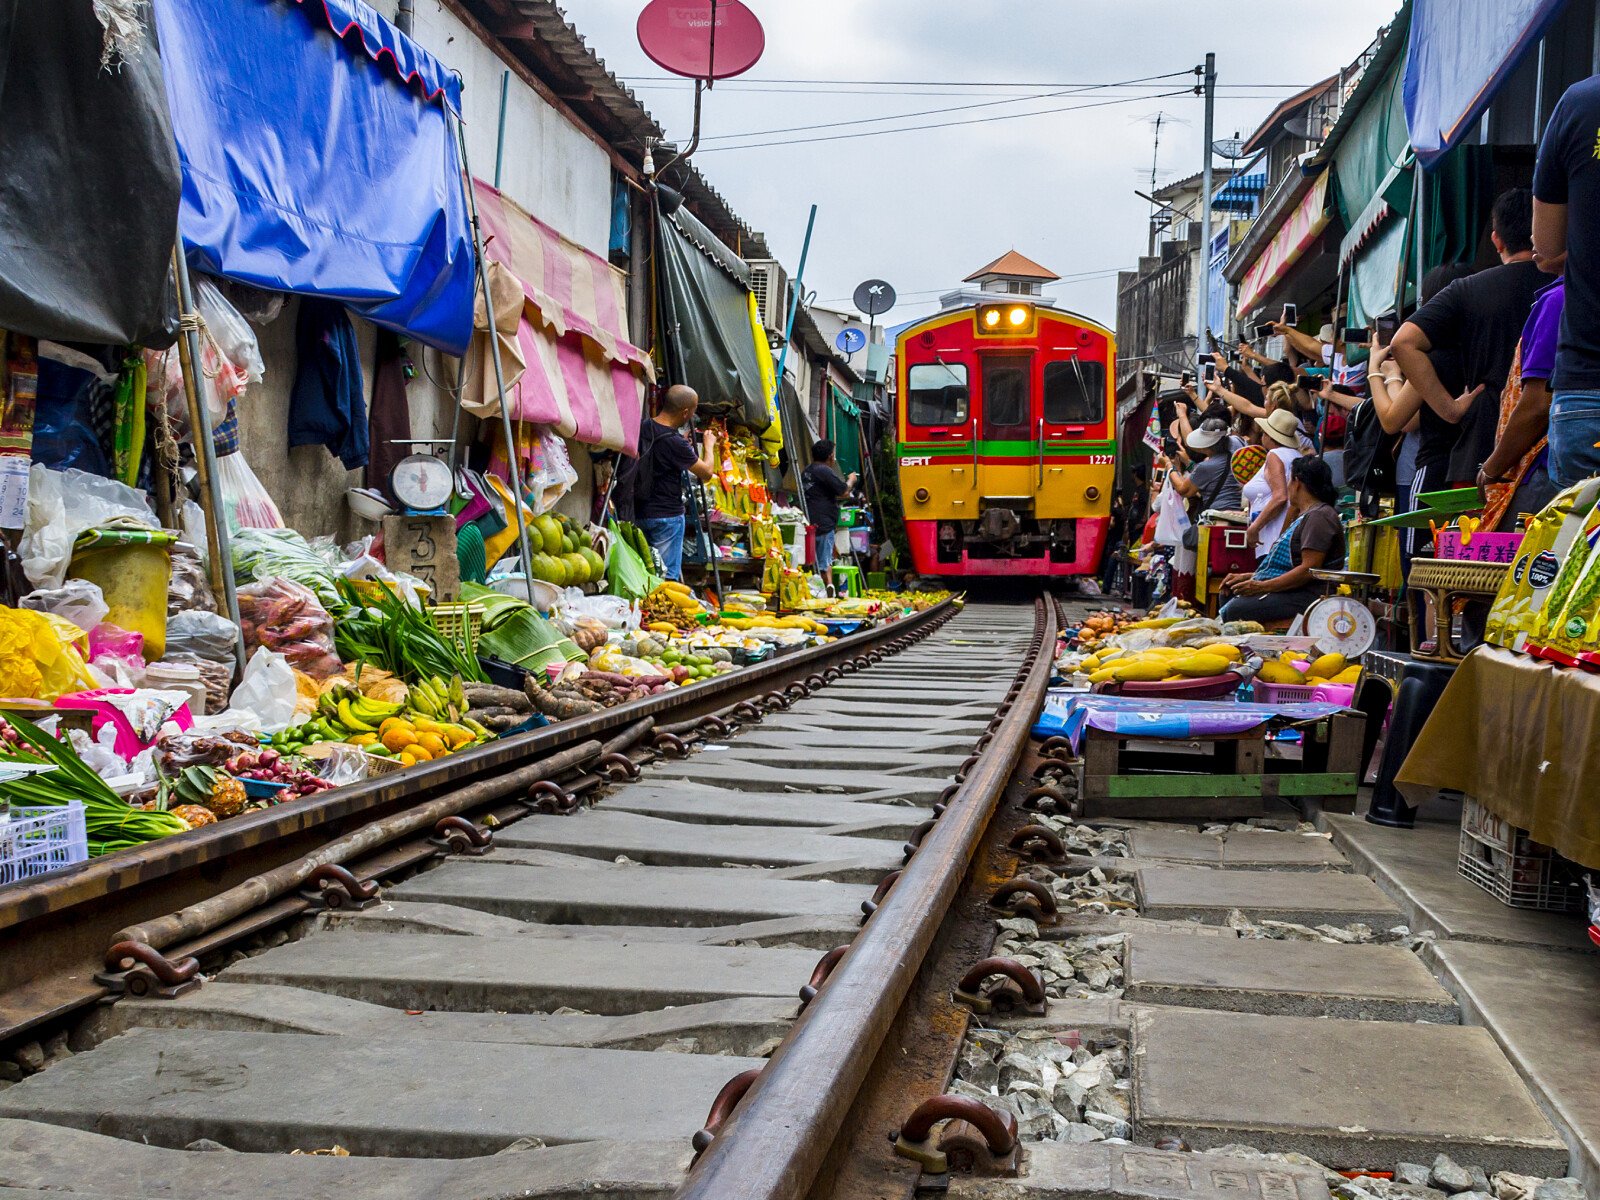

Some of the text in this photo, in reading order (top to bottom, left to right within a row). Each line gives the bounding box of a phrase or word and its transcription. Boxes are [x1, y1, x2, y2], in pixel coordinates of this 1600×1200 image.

[676, 9, 708, 20] true
[901, 456, 932, 466] SRT
[1089, 454, 1114, 465] 1227
[12, 508, 24, 516] 24
[1530, 572, 1548, 583] 100%
